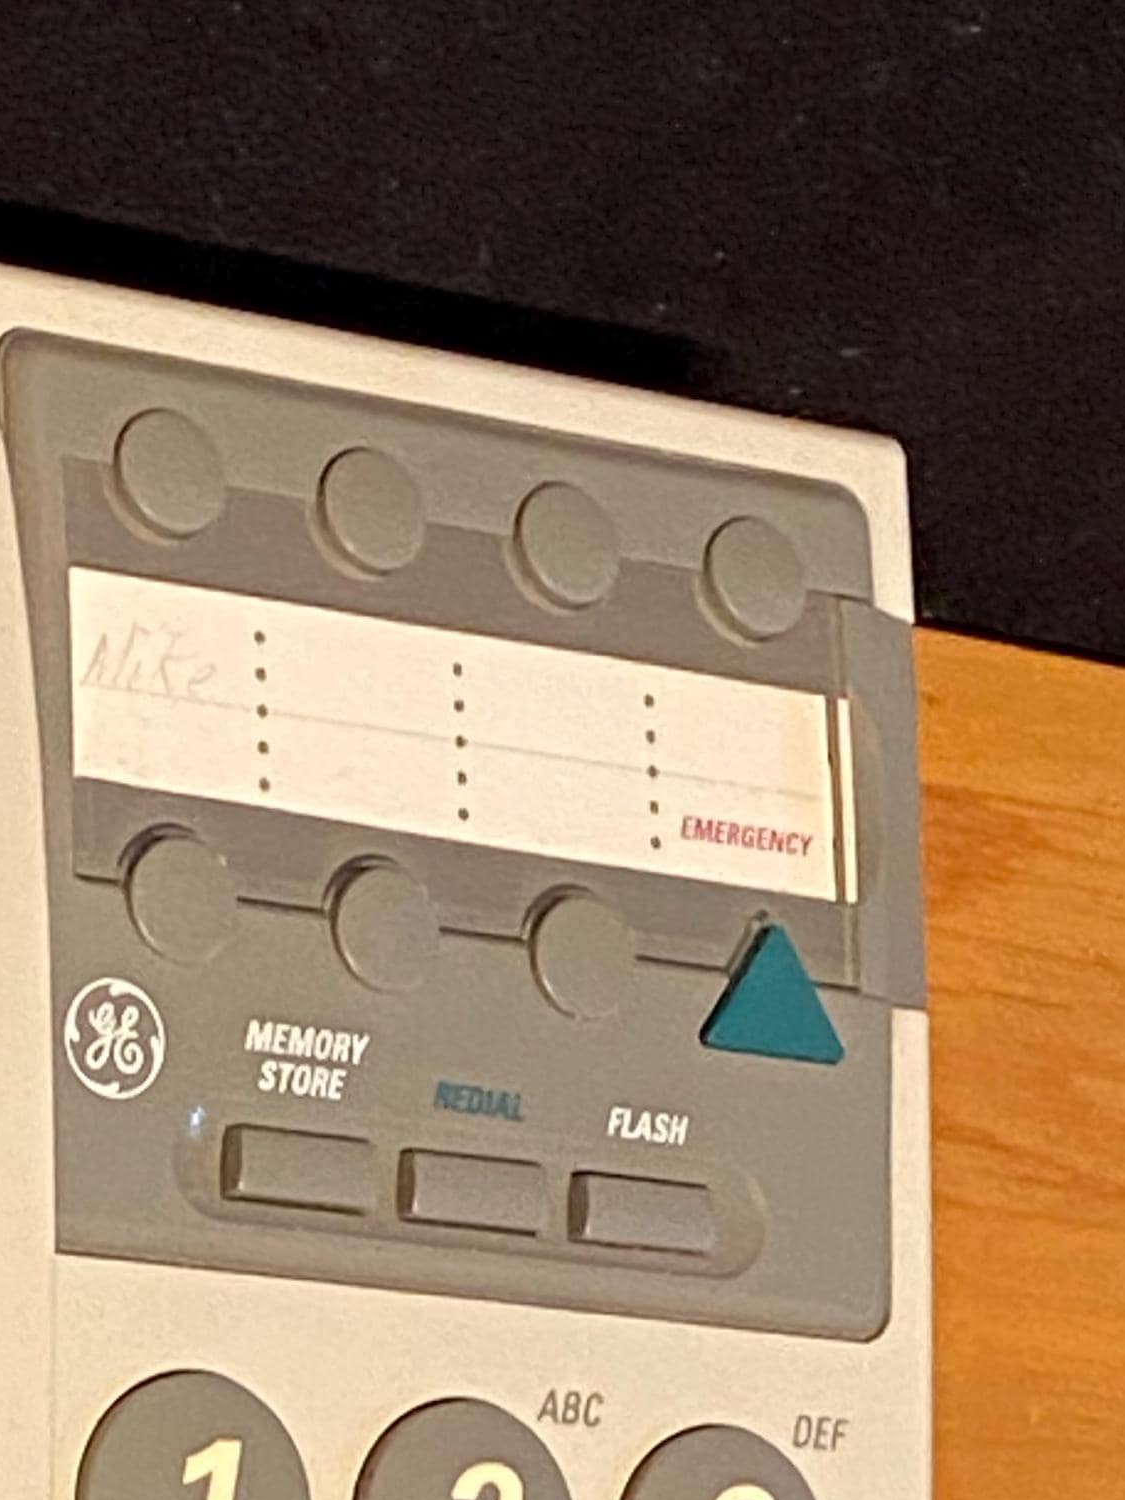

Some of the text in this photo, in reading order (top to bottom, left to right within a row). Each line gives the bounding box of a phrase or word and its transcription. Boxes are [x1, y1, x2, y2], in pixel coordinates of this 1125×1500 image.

[681, 816, 814, 857] EMERGENCY
[244, 1019, 370, 1066] MEMORY
[257, 1060, 348, 1100] STORE
[434, 1081, 524, 1122] REDIAL
[607, 1106, 689, 1146] FLASH
[536, 1388, 604, 1428] ABC
[792, 1414, 850, 1452] DEF
